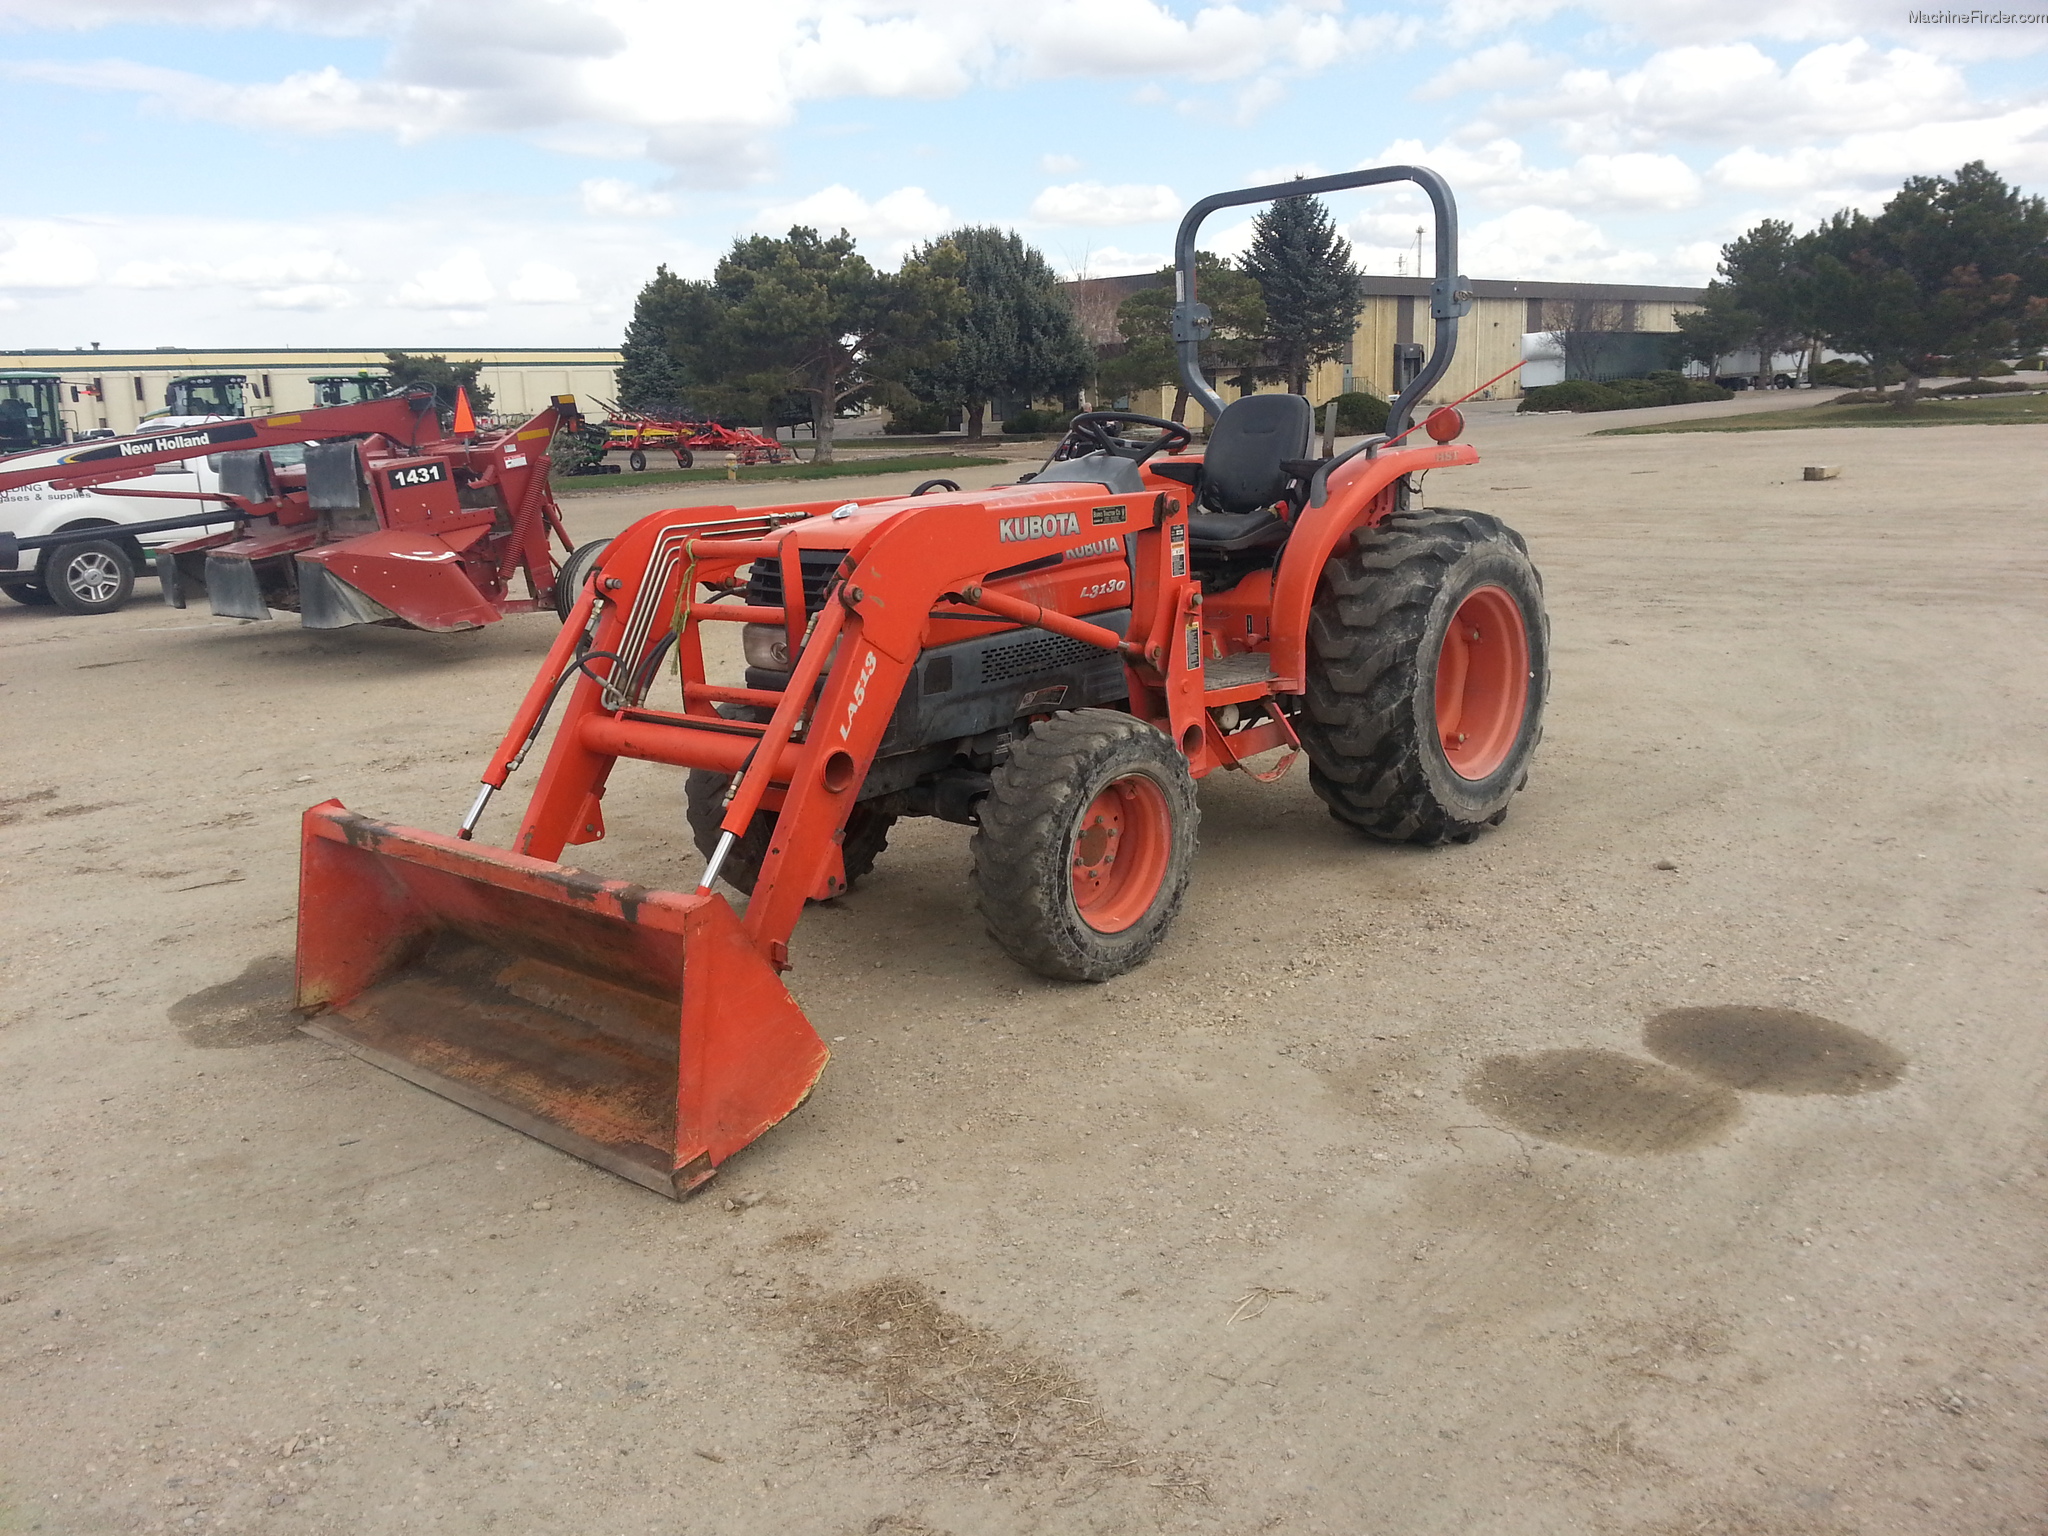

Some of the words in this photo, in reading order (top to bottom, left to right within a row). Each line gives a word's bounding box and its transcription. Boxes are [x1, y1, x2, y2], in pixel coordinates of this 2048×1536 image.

[120, 443, 153, 456] New
[155, 433, 210, 451] Holland
[395, 465, 440, 486] 1431
[35, 493, 42, 501] &
[48, 491, 91, 501] supplies
[999, 512, 1081, 543] KUBOTA
[1080, 579, 1126, 599] L3130
[840, 651, 876, 742] LA513
